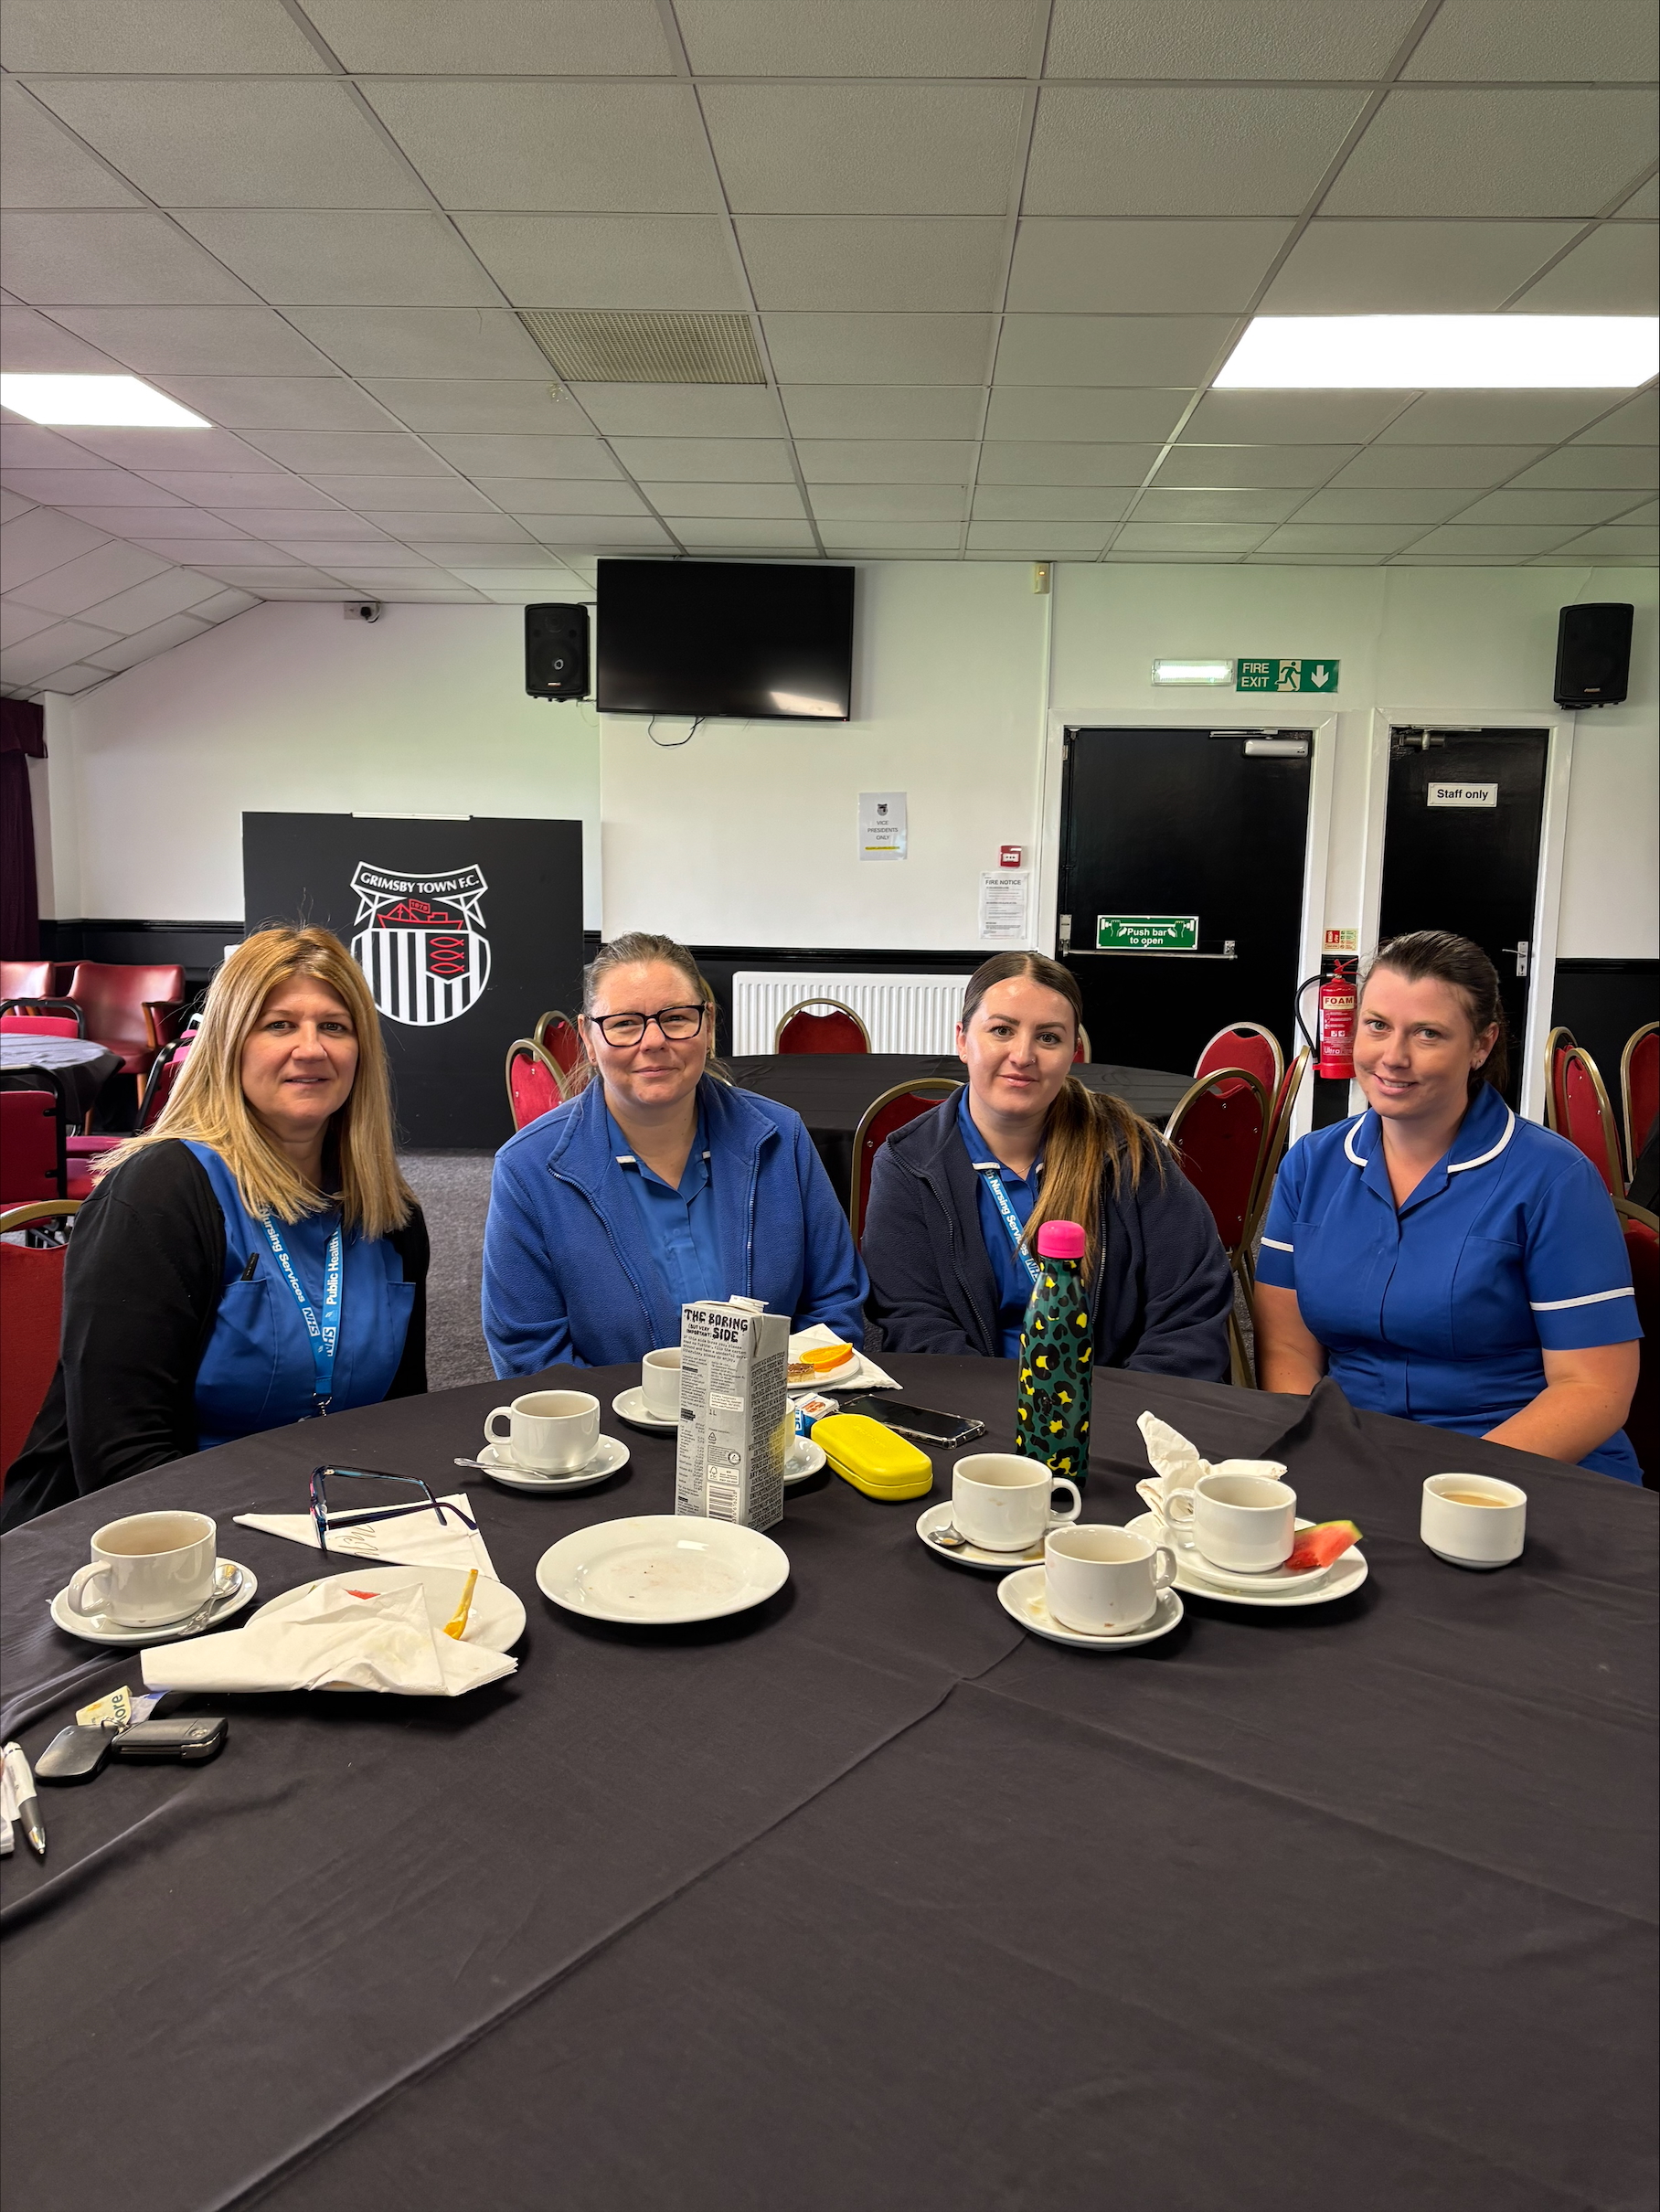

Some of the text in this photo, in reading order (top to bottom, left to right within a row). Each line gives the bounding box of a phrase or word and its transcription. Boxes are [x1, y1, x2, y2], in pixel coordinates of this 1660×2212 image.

[1242, 663, 1270, 674] FIRE
[1240, 676, 1270, 687] EXIT
[1437, 789, 1488, 801] Staff only
[360, 872, 480, 893] GRIMSBY TOWN F.C.
[1127, 927, 1150, 936] Push
[1141, 938, 1164, 946] open
[990, 1179, 1011, 1215] Nursing
[328, 1238, 339, 1272] Health
[261, 1207, 320, 1336] Nursing Services NHS
[326, 1272, 338, 1305] Public
[684, 1309, 748, 1332] THE BORING
[713, 1327, 739, 1343] SIDE
